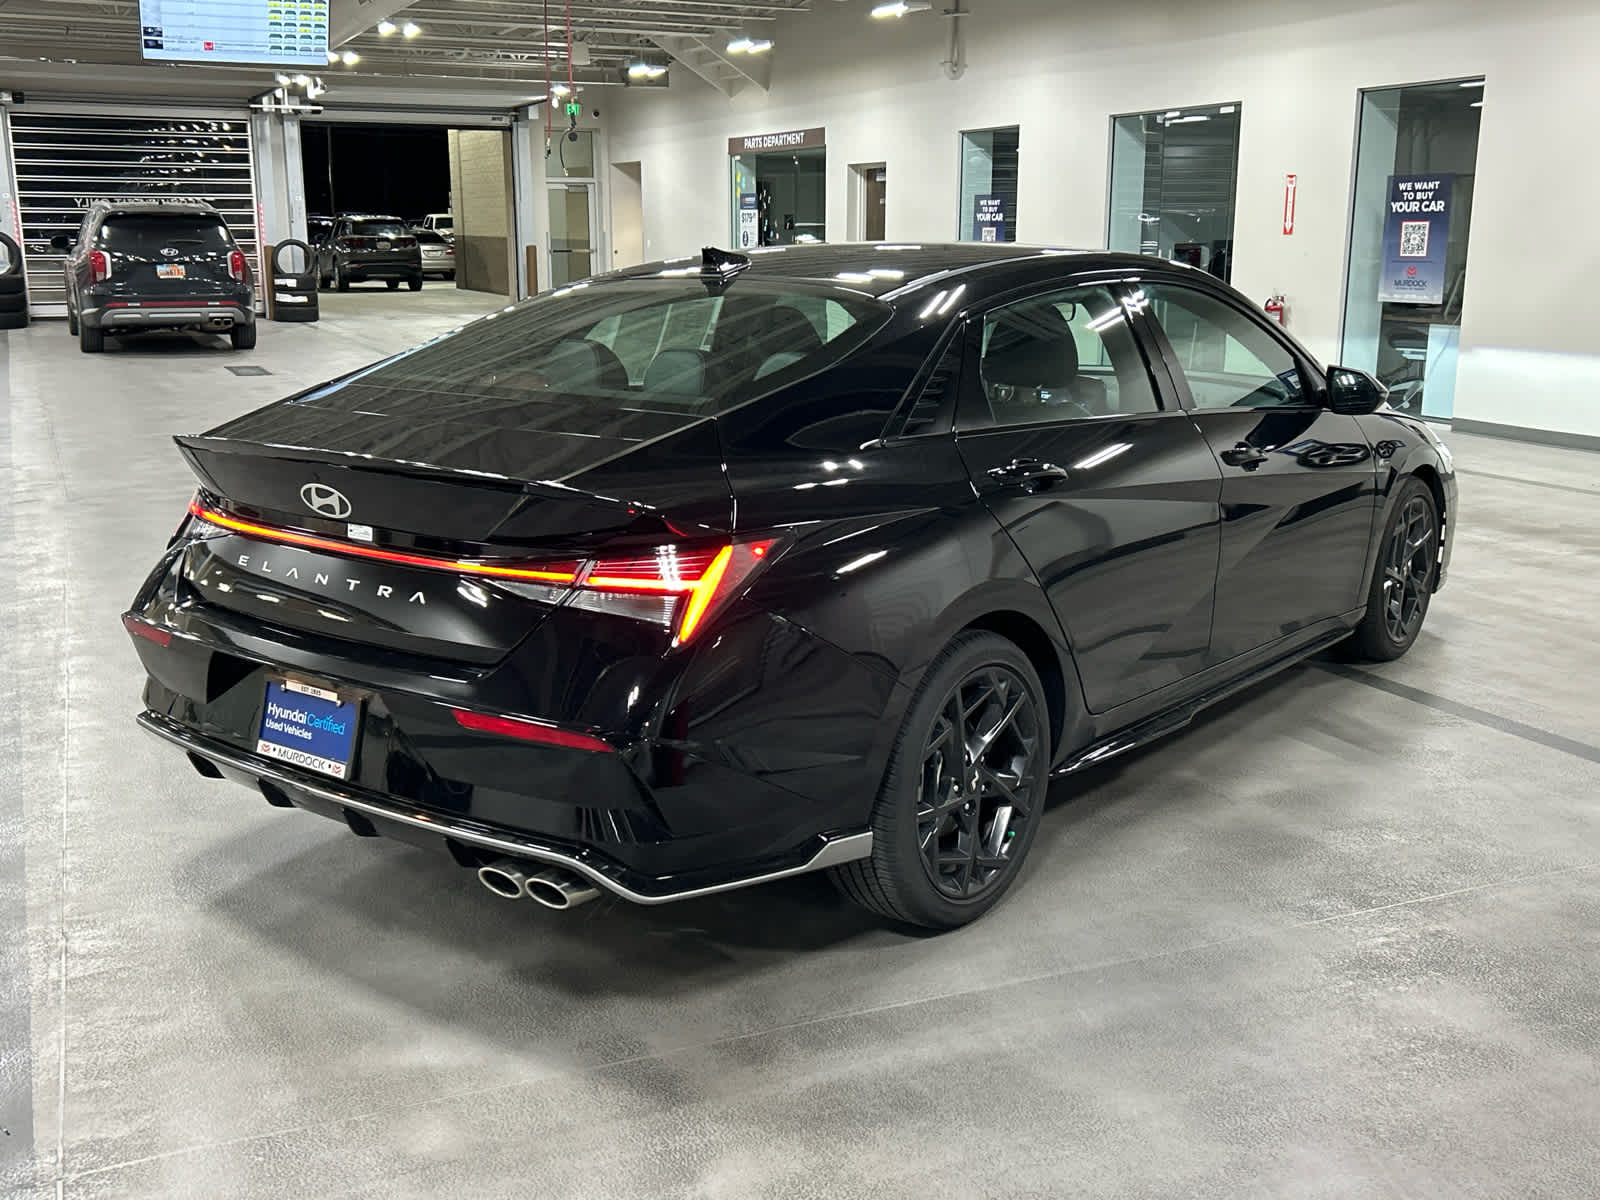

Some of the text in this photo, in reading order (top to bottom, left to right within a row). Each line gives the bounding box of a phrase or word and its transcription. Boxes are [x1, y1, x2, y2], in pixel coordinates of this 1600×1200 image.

[744, 132, 805, 149] PARTS DEPARTMENT
[1398, 181, 1440, 190] WE WANT
[1403, 191, 1434, 200] TO BUY
[1391, 200, 1445, 213] YOUR CAR
[976, 212, 1004, 222] YOUR CAR
[237, 554, 426, 605] ELANTRA
[265, 718, 313, 741] Used Vehicles
[277, 747, 326, 770] MURDOCK
